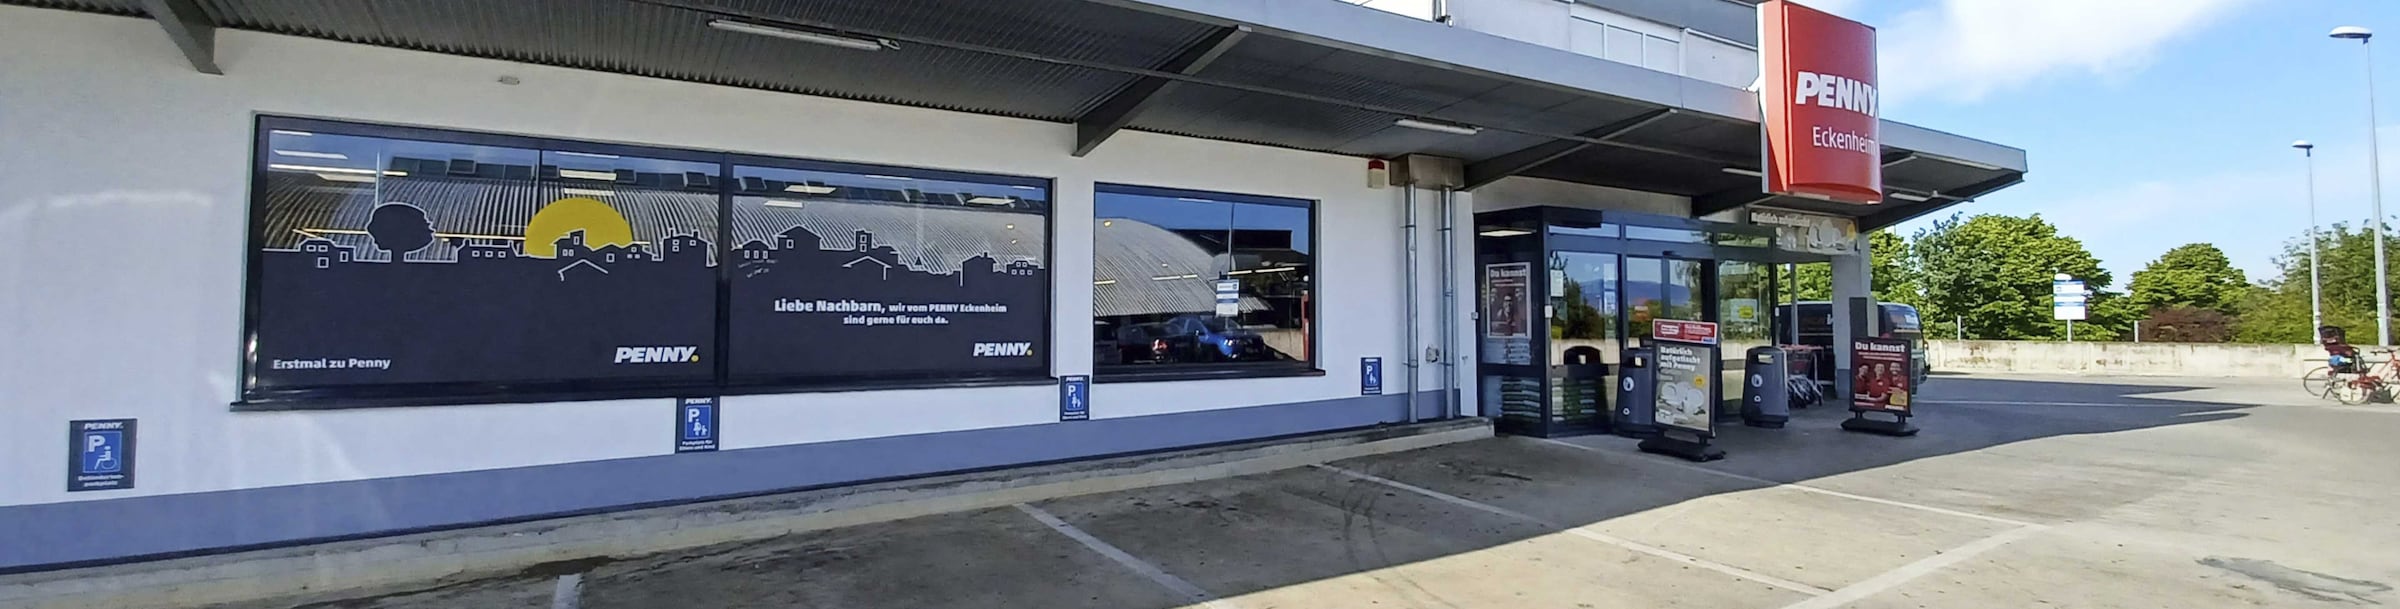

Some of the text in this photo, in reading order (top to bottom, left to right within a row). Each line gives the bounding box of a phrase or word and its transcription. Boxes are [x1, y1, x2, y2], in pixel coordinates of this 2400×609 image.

[1795, 71, 1877, 117] PENNY
[1812, 126, 1876, 156] Eckenheim
[774, 298, 1007, 314] Liebe Nachbarn, wir vom PENNY Eckenheim
[843, 314, 949, 326] sind gerne für euch da.
[1855, 341, 1905, 352] Du kannst
[273, 358, 391, 370] Erstmal zu Penny
